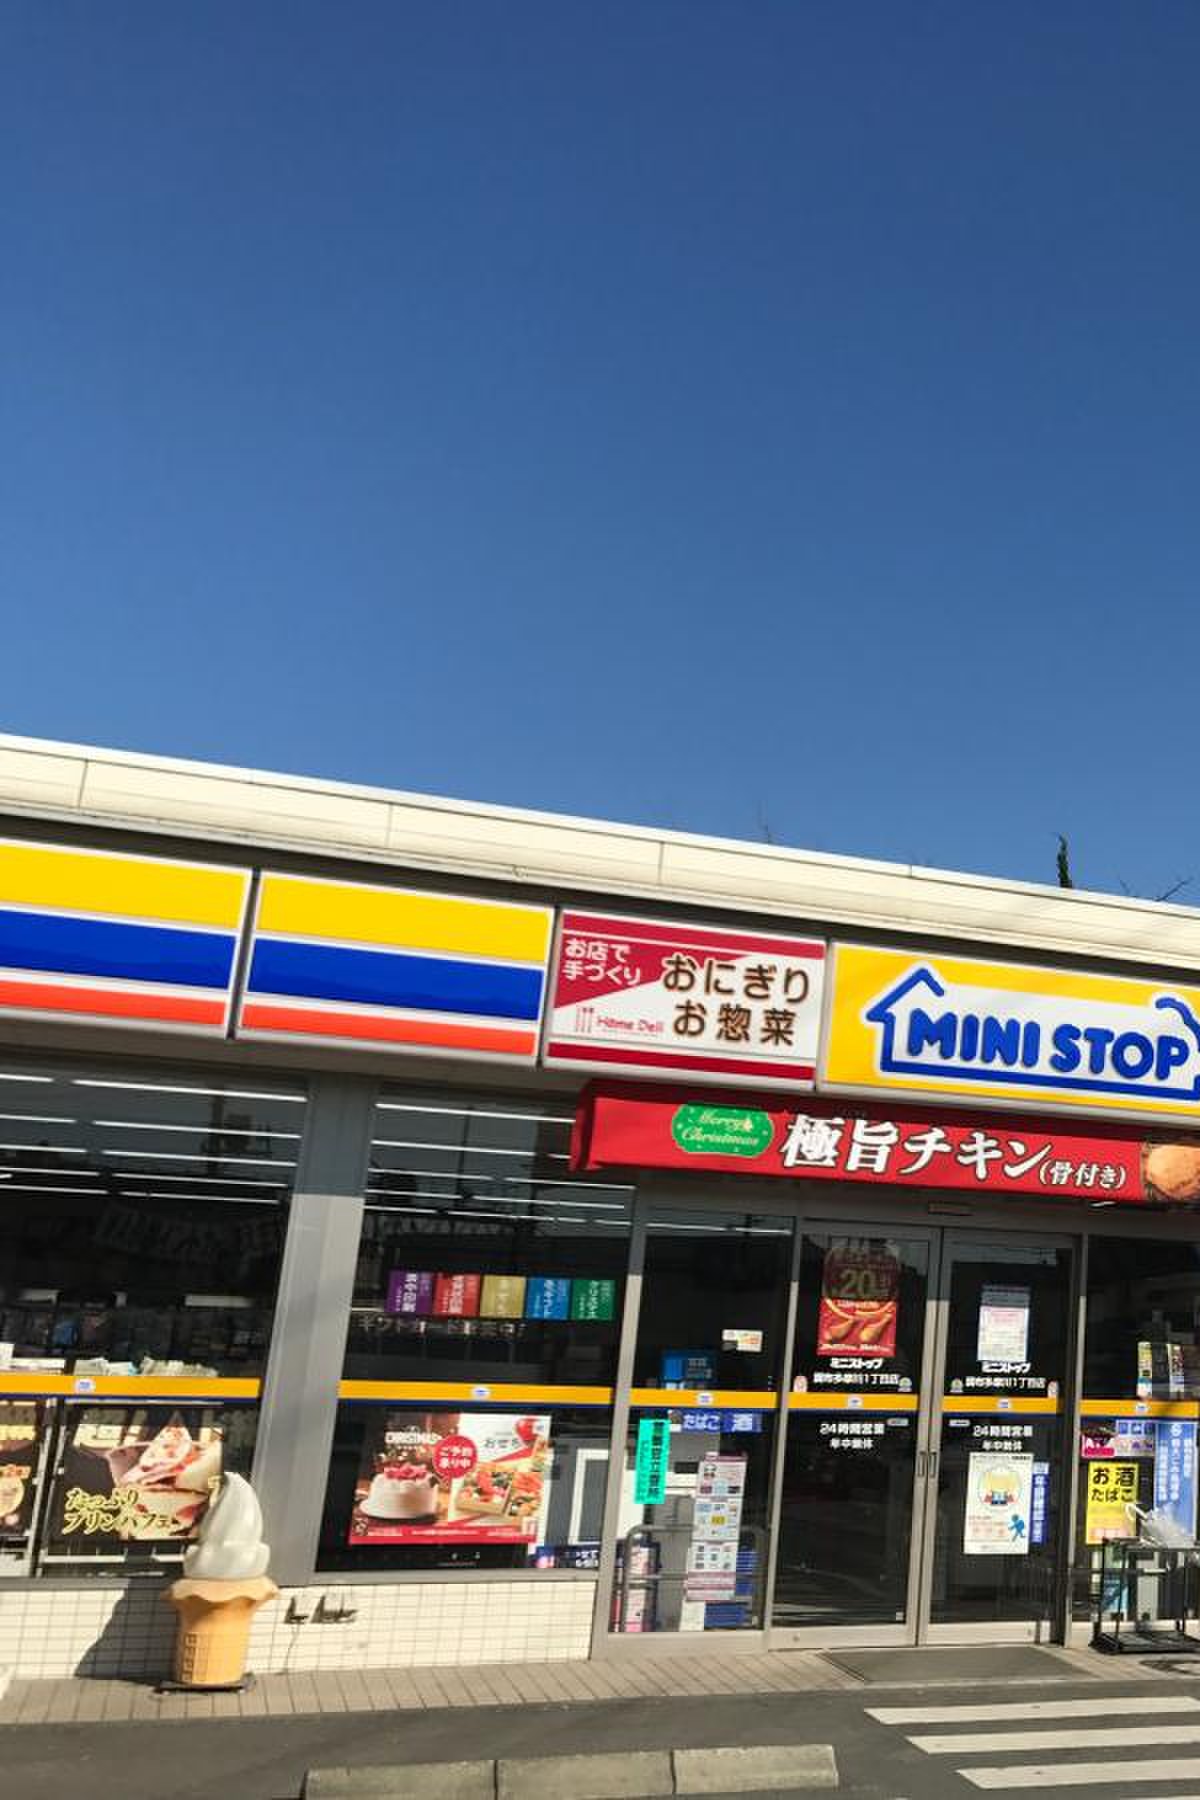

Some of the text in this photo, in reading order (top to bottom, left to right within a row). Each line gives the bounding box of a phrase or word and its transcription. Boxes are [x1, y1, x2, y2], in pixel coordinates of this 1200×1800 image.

[565, 938, 631, 963] お店で
[562, 960, 640, 985] 手づくり
[662, 954, 809, 1004] おにぎり
[672, 1000, 796, 1046] お惣菜
[906, 1008, 1189, 1080] MINI STOP
[780, 1113, 1051, 1180] 極旨チキン
[829, 1357, 884, 1370] ミニストップ
[1092, 1466, 1135, 1487] お酒
[1091, 1488, 1135, 1503] たばこ
